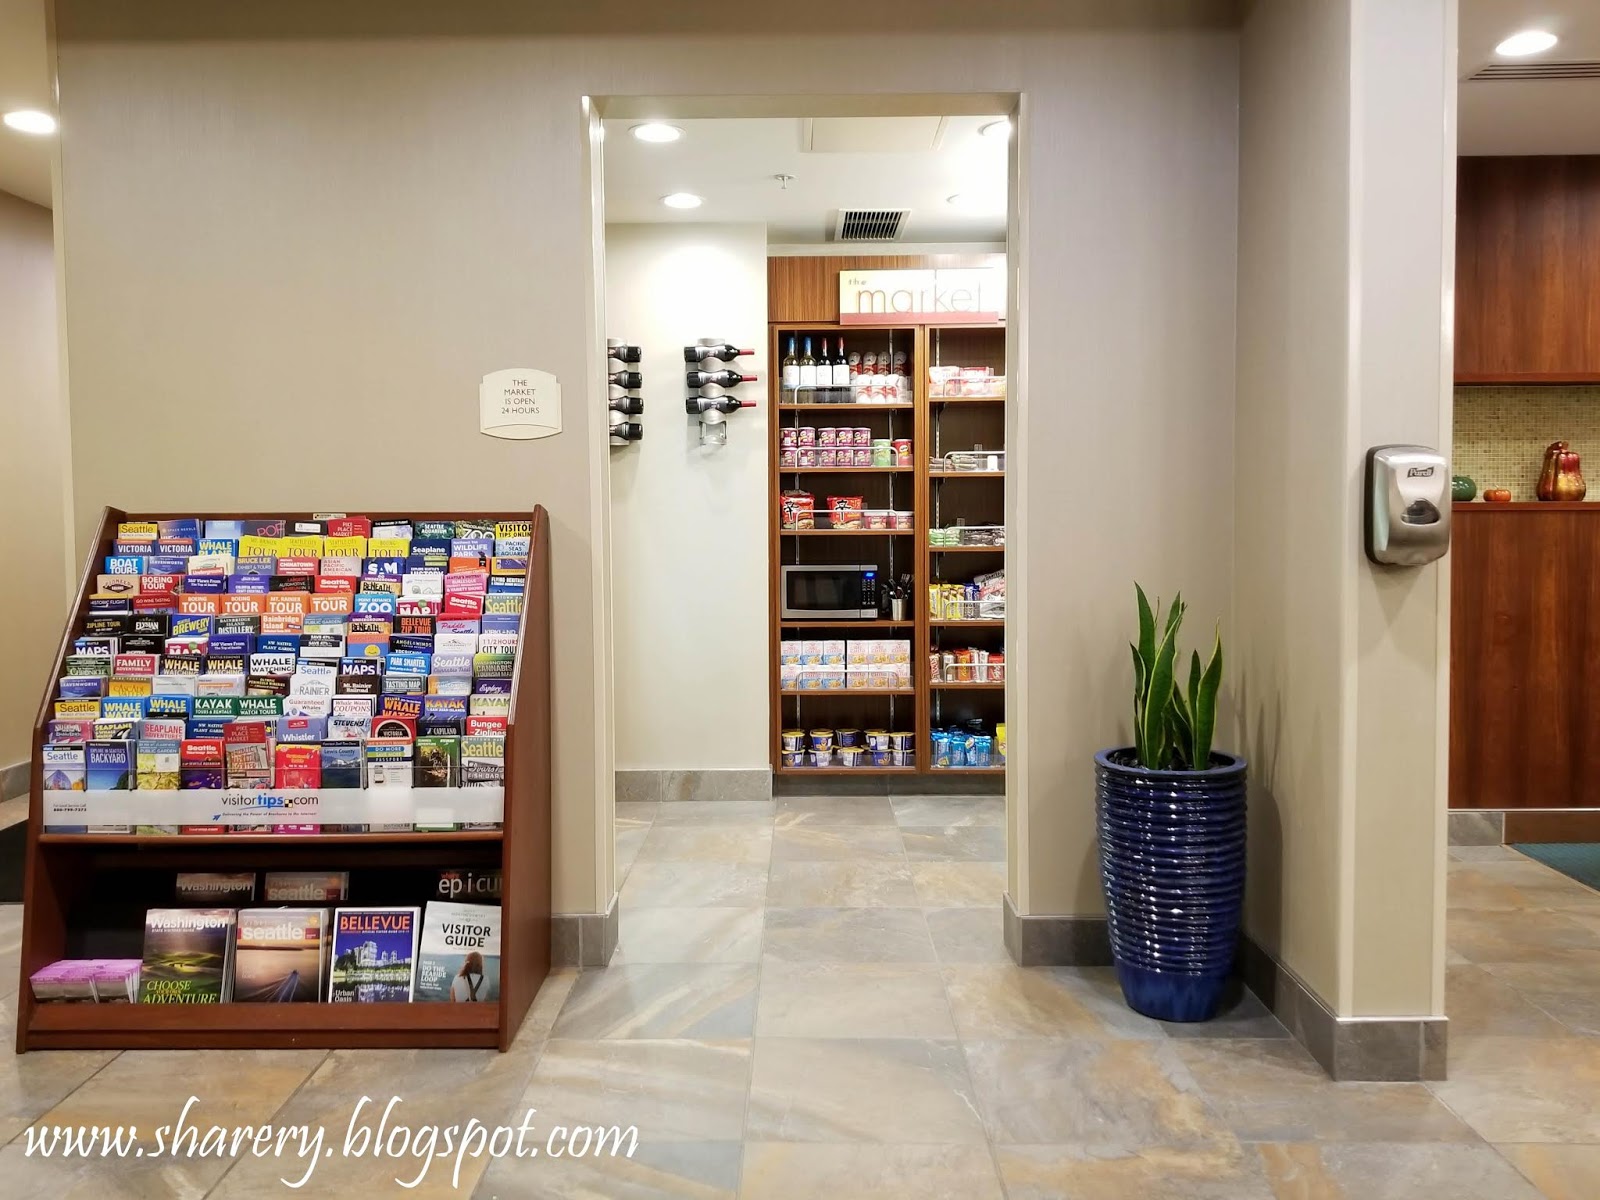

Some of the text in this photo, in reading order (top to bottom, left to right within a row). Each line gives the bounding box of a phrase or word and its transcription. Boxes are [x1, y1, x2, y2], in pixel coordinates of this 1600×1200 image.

[1408, 467, 1432, 477] Purell
[122, 525, 154, 534] Seattle
[462, 528, 495, 539] ZOO
[247, 546, 278, 556] TOUR
[288, 548, 317, 557] TOUR
[330, 548, 358, 557] TOUR
[413, 546, 445, 555] Seaplane
[110, 559, 138, 567] BOAT
[451, 597, 476, 605] Seattle
[182, 602, 215, 612] TOUR
[225, 602, 258, 612] TOUR
[270, 602, 302, 613] TOUR
[313, 601, 347, 611] TOUR
[359, 604, 392, 612] ZOO
[173, 617, 209, 636] BREWERY
[352, 623, 379, 631] BENEATH
[76, 647, 108, 655] MAPS
[165, 660, 199, 671] WHALE
[208, 660, 243, 669] WHALE
[390, 658, 402, 666] PARK
[434, 657, 470, 667] Seattle
[343, 665, 375, 675] MAPS
[105, 703, 140, 711] WHALE
[150, 700, 186, 709] WHALE
[195, 699, 232, 708] KAYAK
[239, 699, 276, 708] WHALE
[384, 699, 420, 713] WHALE
[426, 700, 464, 708] KAYAK
[473, 698, 509, 707] KAYAK
[60, 704, 95, 712] Seattle
[144, 724, 182, 733] SEAPLANE
[462, 741, 503, 757] Seattle
[91, 754, 126, 763] BACKYARD
[181, 881, 251, 893] Washington
[268, 884, 324, 900] seattle
[151, 917, 226, 929] Washington
[341, 916, 410, 929] BELLEVUE
[242, 922, 304, 940] seattle
[442, 923, 491, 936] VISITOR
[445, 936, 485, 947] GUIDE
[147, 980, 191, 990] CHOOSE
[144, 994, 216, 1003] ADVENTURE
